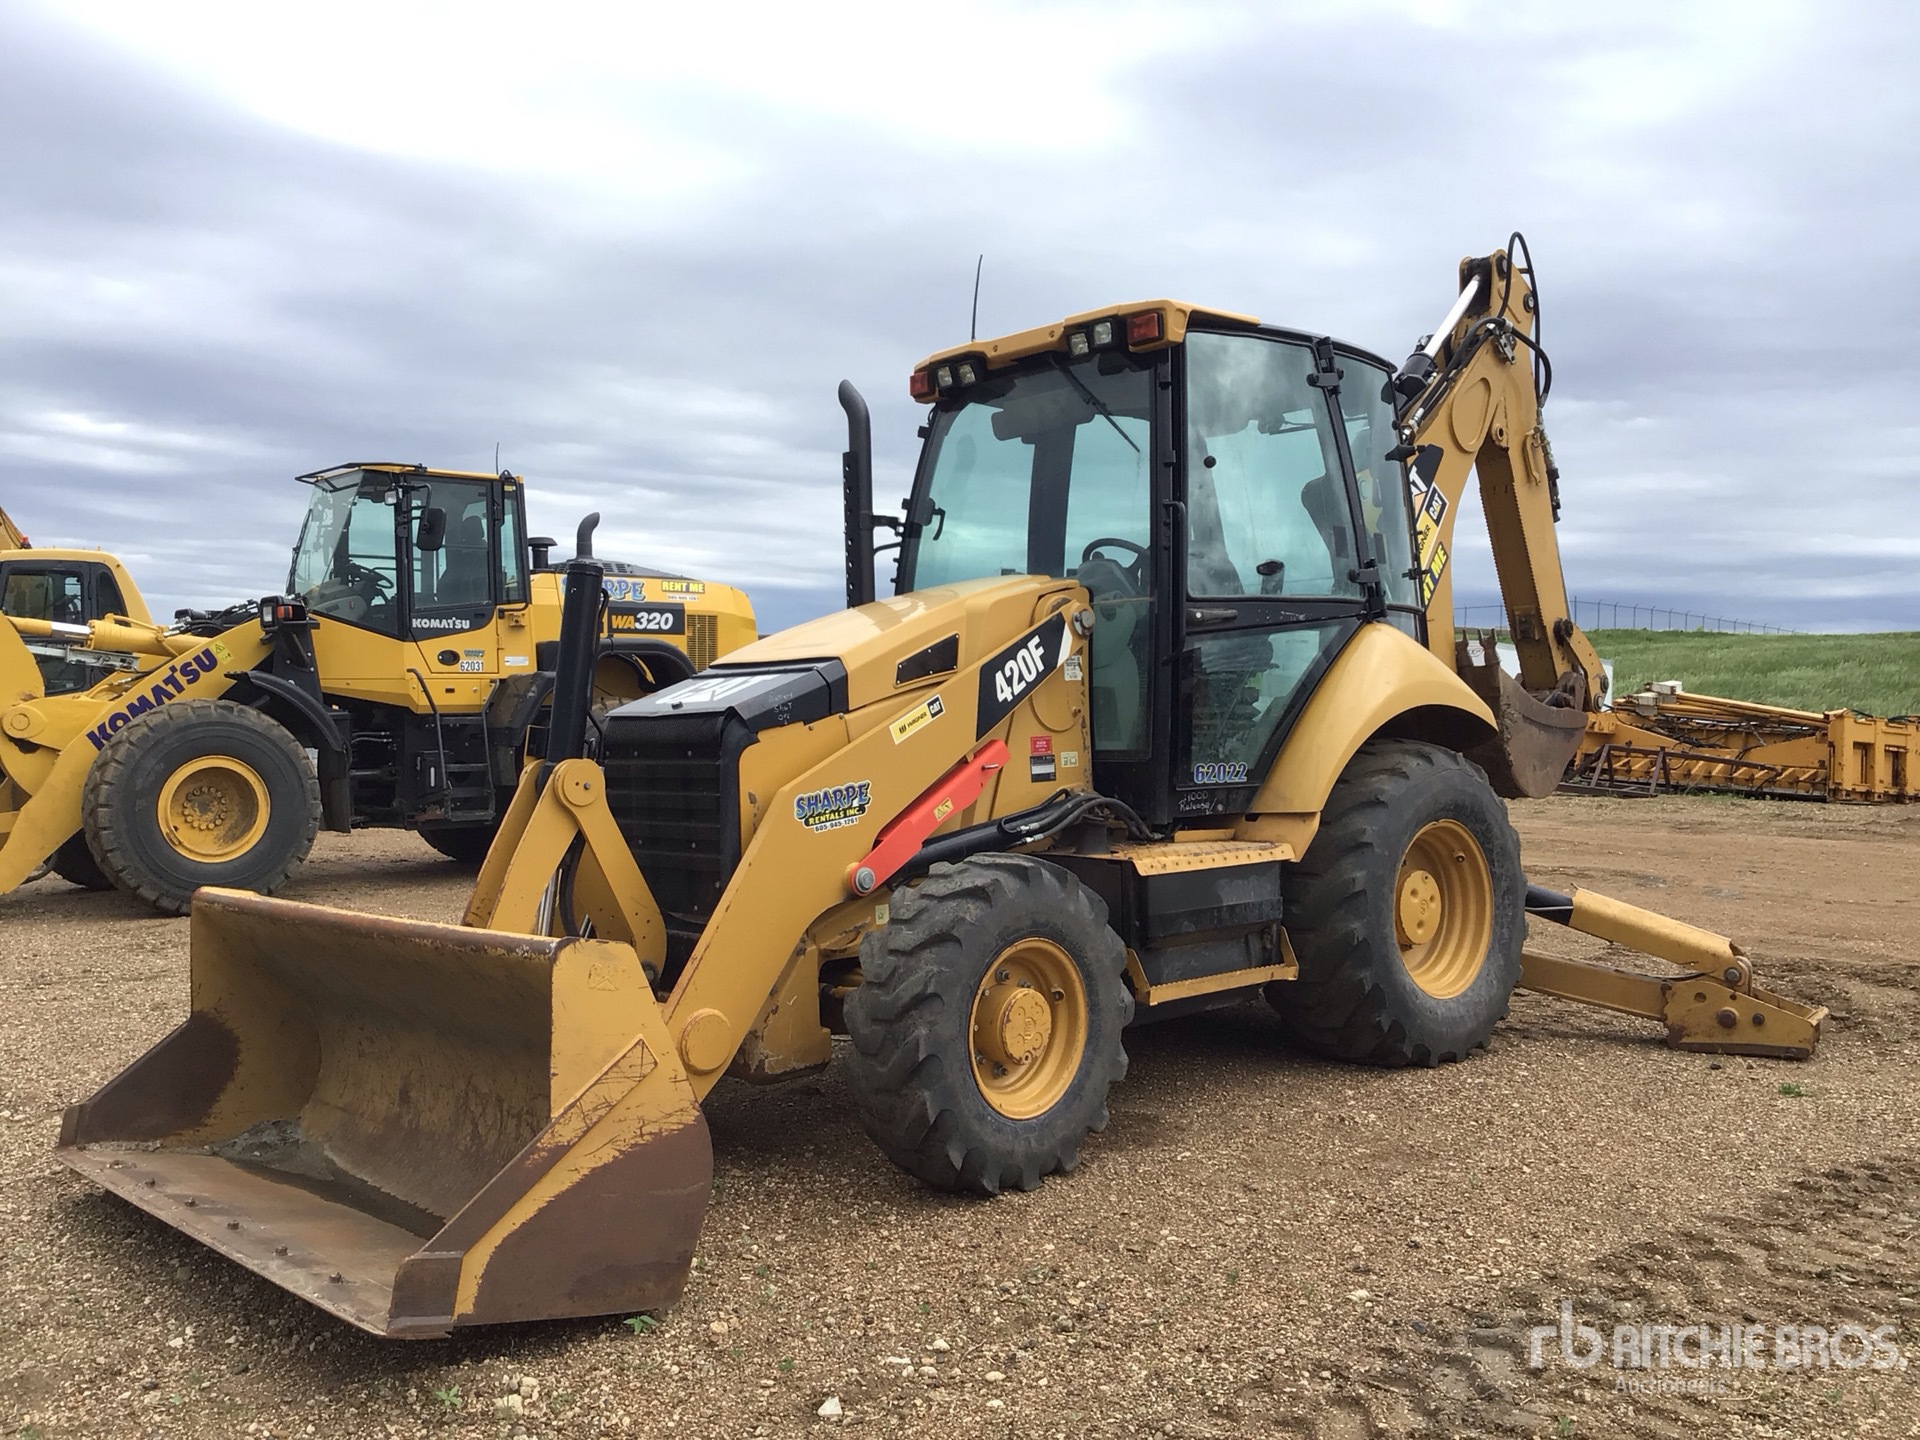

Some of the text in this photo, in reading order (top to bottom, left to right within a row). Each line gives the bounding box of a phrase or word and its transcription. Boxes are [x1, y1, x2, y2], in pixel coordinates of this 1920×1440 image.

[1429, 493, 1443, 520] CAT
[1430, 543, 1447, 580] ME
[662, 581, 705, 593] RENT ME
[412, 617, 470, 629] KOMATSU
[611, 611, 674, 630] WA320
[460, 661, 484, 672] 62031
[994, 634, 1045, 704] 420F
[86, 648, 218, 751] KOMATSU
[929, 700, 942, 715] CAT
[1194, 762, 1248, 784] 62022
[795, 781, 871, 820] SHARPE
[808, 807, 863, 826] RENTALS INC.
